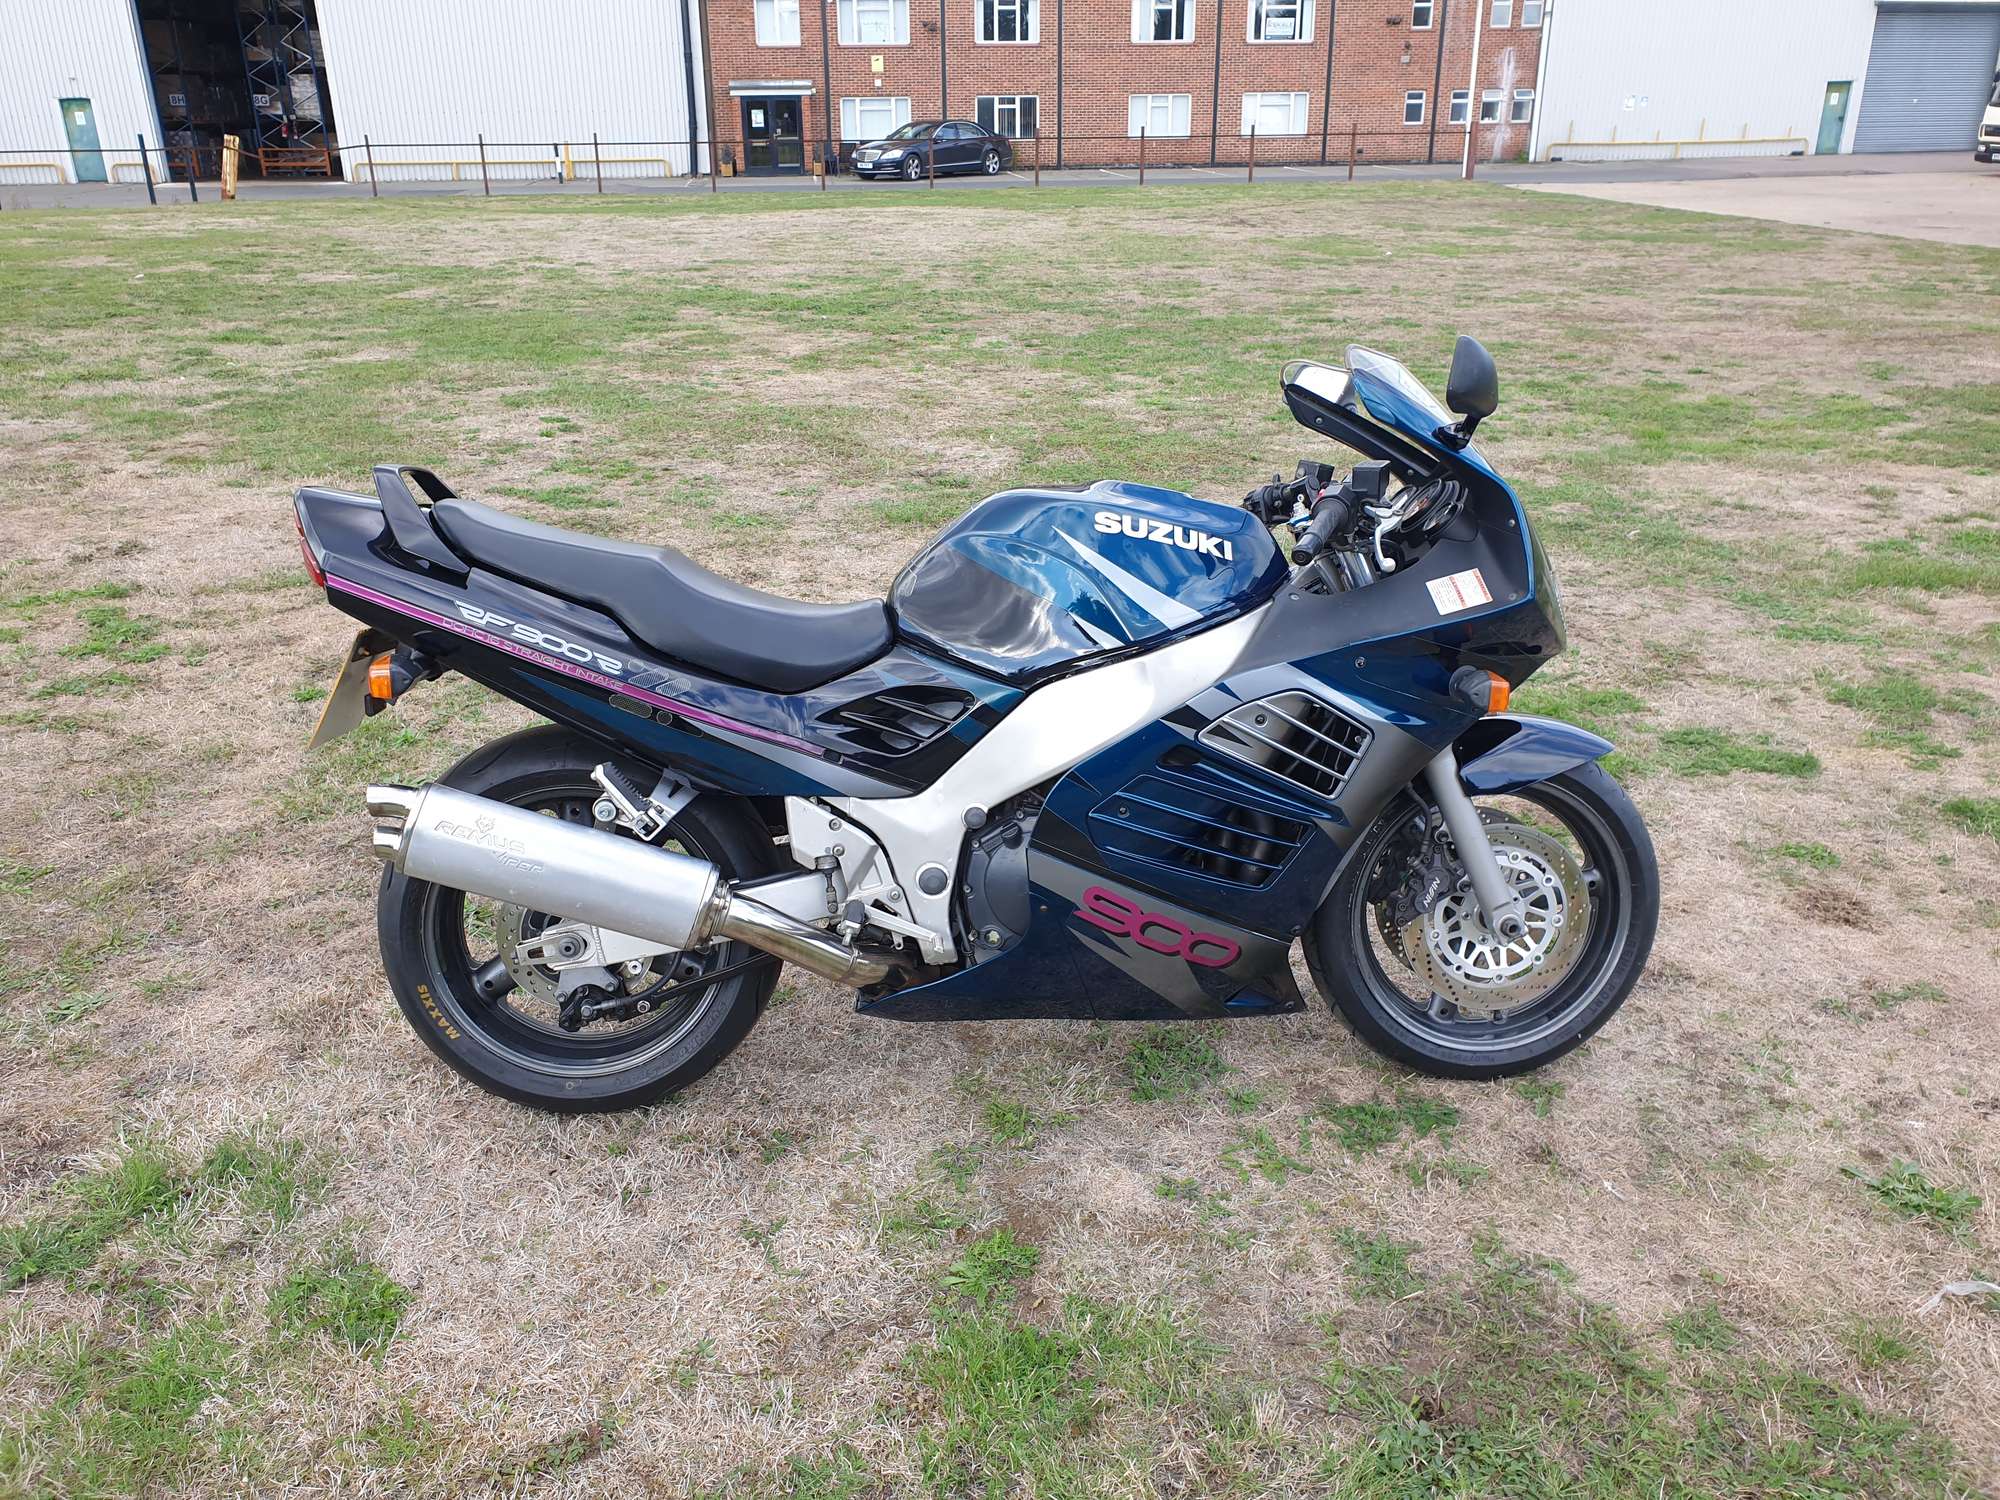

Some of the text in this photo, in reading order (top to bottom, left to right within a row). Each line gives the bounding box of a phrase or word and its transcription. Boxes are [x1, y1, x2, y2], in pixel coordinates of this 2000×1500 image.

[1094, 511, 1233, 561] SUZUKI
[504, 639, 575, 673] STRAIGHT
[575, 667, 626, 691] INTAKE
[434, 820, 526, 855] REMUS
[1072, 886, 1242, 969] 900
[416, 984, 461, 1039] MAXXIS
